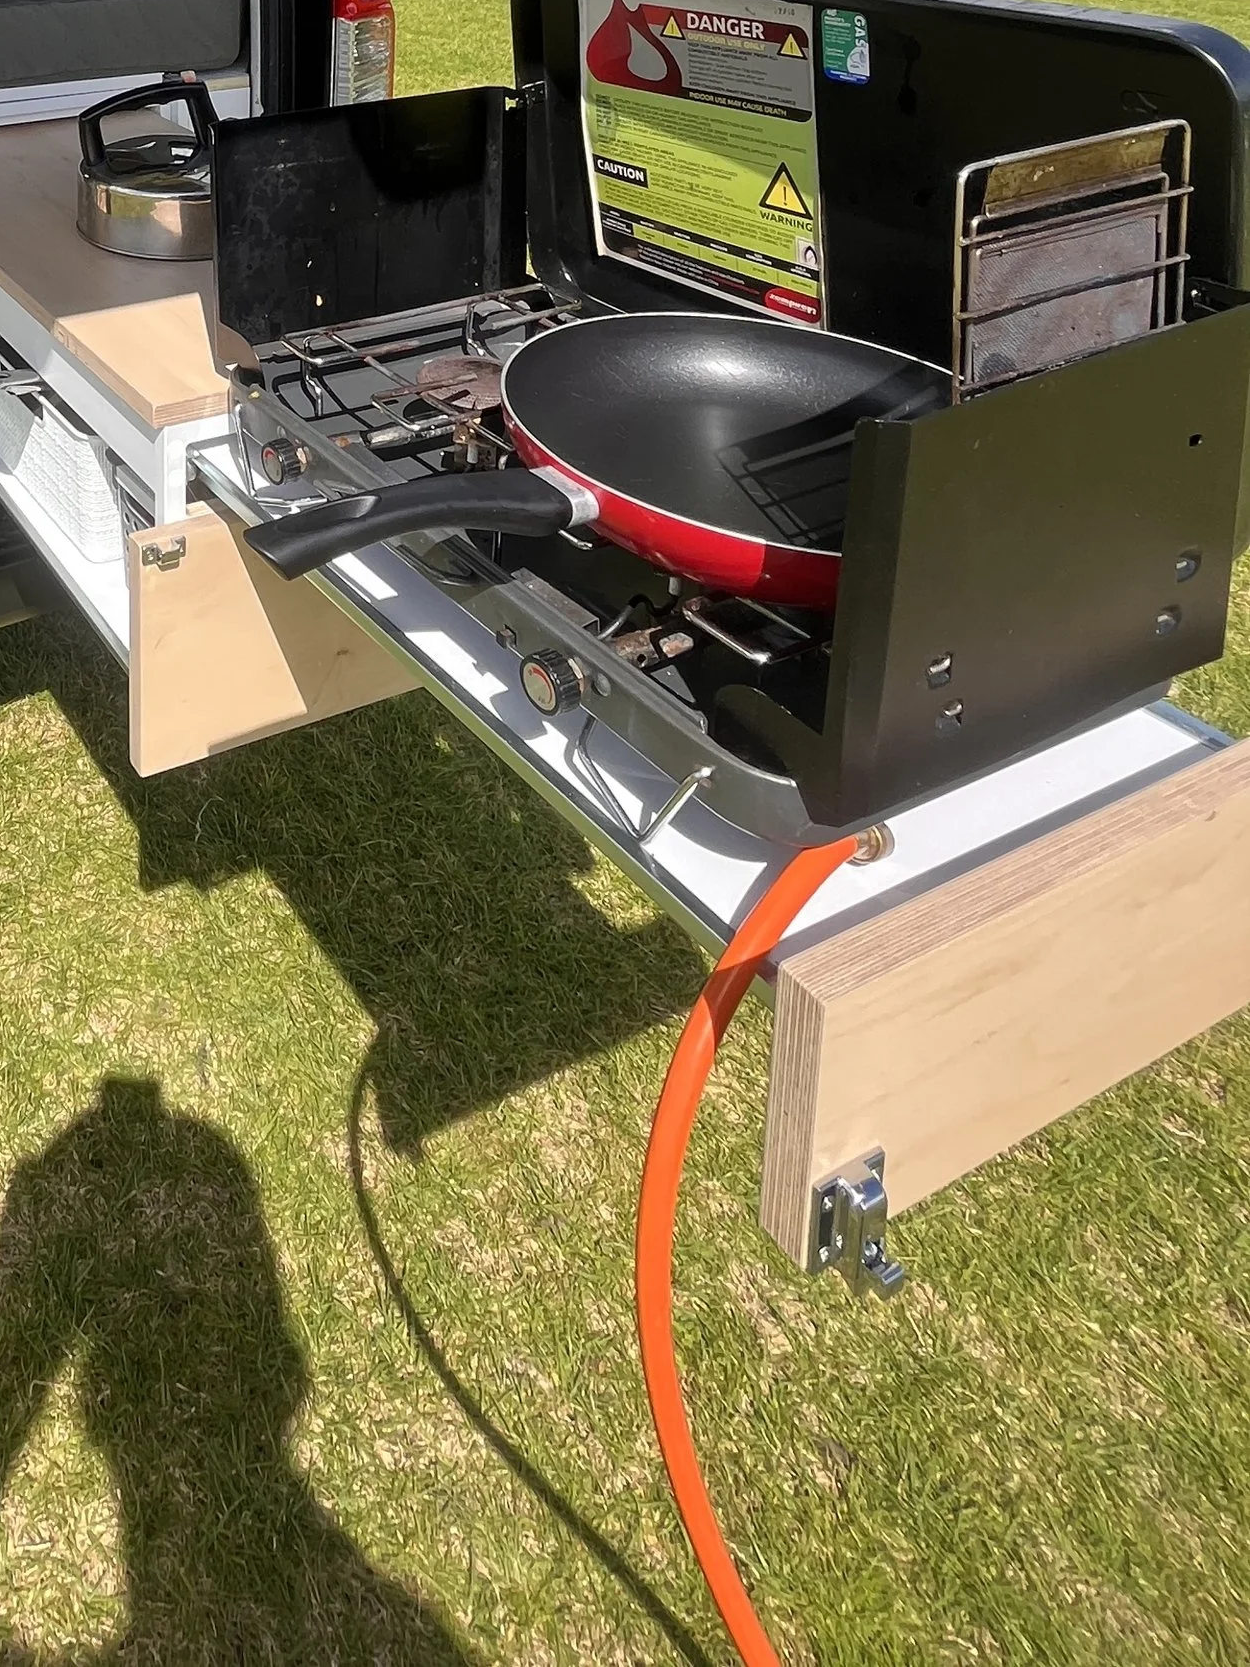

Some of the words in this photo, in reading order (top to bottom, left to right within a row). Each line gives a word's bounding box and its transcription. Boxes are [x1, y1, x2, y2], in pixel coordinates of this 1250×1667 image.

[686, 12, 766, 40] DANGER
[687, 33, 726, 46] OUTDOOR
[726, 38, 743, 47] USE
[743, 41, 766, 52] ONLY
[689, 91, 714, 103] INDOOR
[715, 96, 727, 105] USE
[727, 98, 742, 108] MAY
[742, 101, 764, 112] CAUSE
[764, 105, 787, 117] DEATH
[597, 159, 645, 183] CAUTION
[759, 210, 814, 233] WARNING
